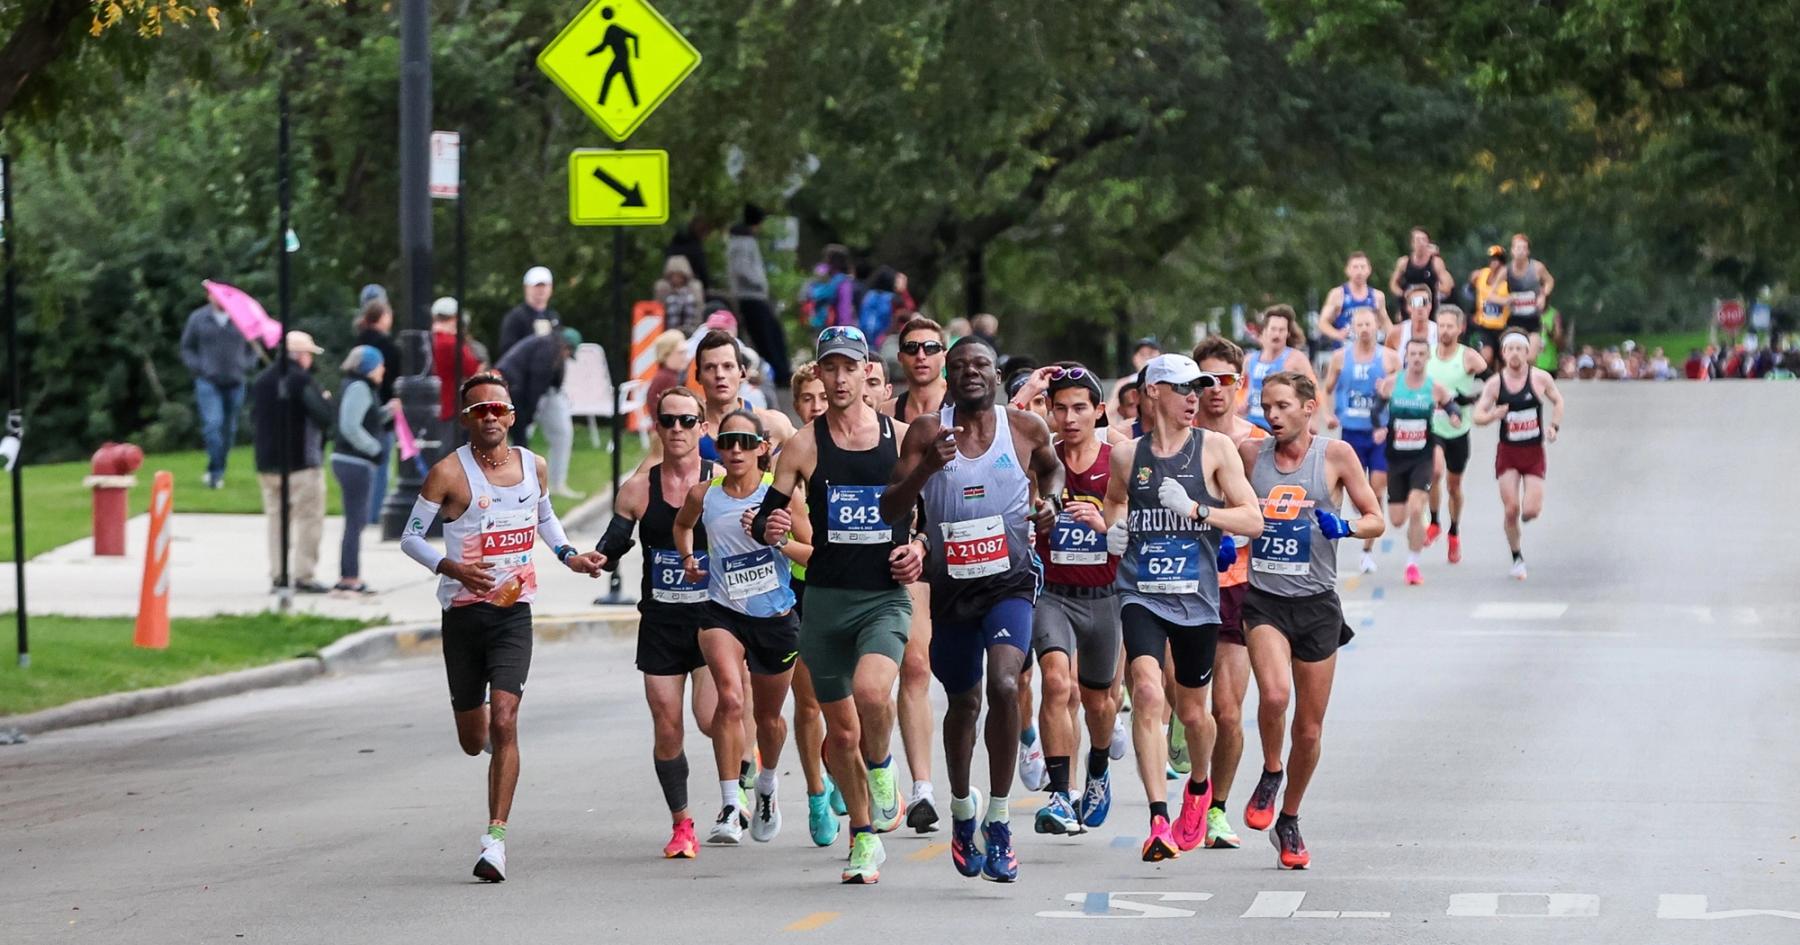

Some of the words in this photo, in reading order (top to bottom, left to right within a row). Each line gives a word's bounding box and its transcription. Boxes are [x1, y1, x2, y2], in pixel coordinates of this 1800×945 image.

[839, 506, 880, 524] 843
[485, 536, 495, 548] A
[499, 530, 534, 546] 25017
[1059, 528, 1098, 546] 794
[1261, 536, 1298, 555] 758
[947, 545, 956, 557] A
[959, 538, 1004, 557] 21087
[1149, 557, 1187, 574] 627
[662, 569, 697, 584] 87
[728, 565, 773, 586] LINDEN
